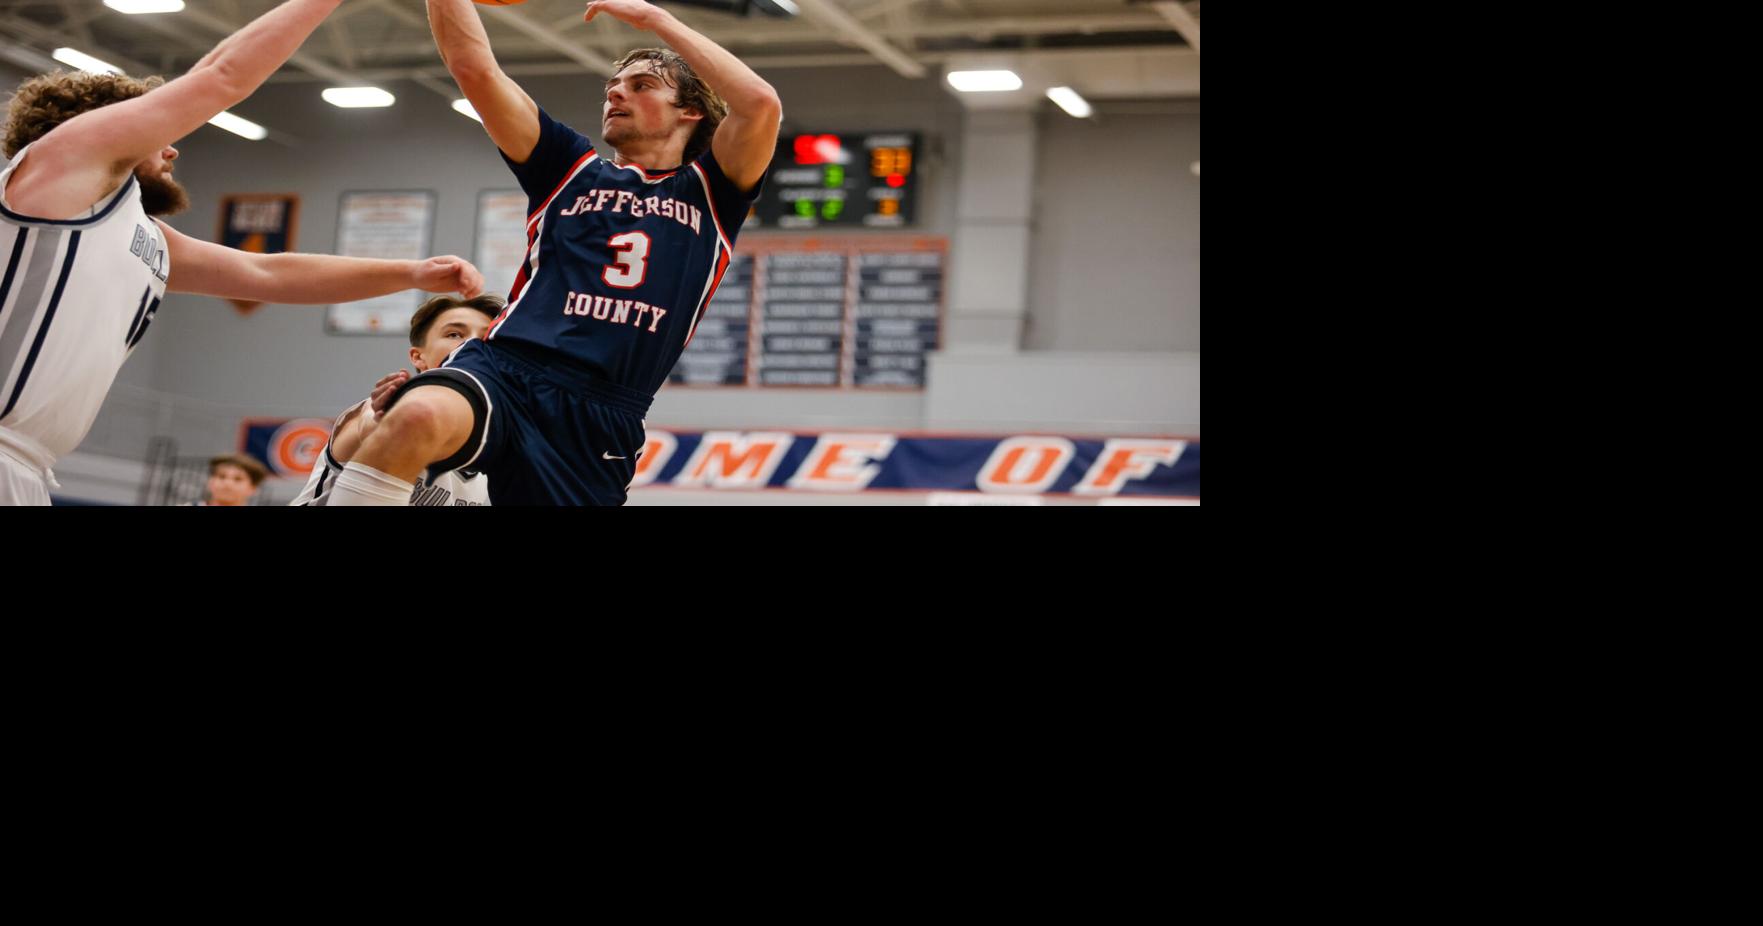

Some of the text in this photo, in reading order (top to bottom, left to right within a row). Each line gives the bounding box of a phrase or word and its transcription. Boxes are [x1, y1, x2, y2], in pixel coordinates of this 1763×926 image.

[560, 189, 702, 236] JEFFERSON
[601, 230, 652, 289] 3
[563, 291, 667, 333] COUNTY
[975, 435, 1187, 495] OF
